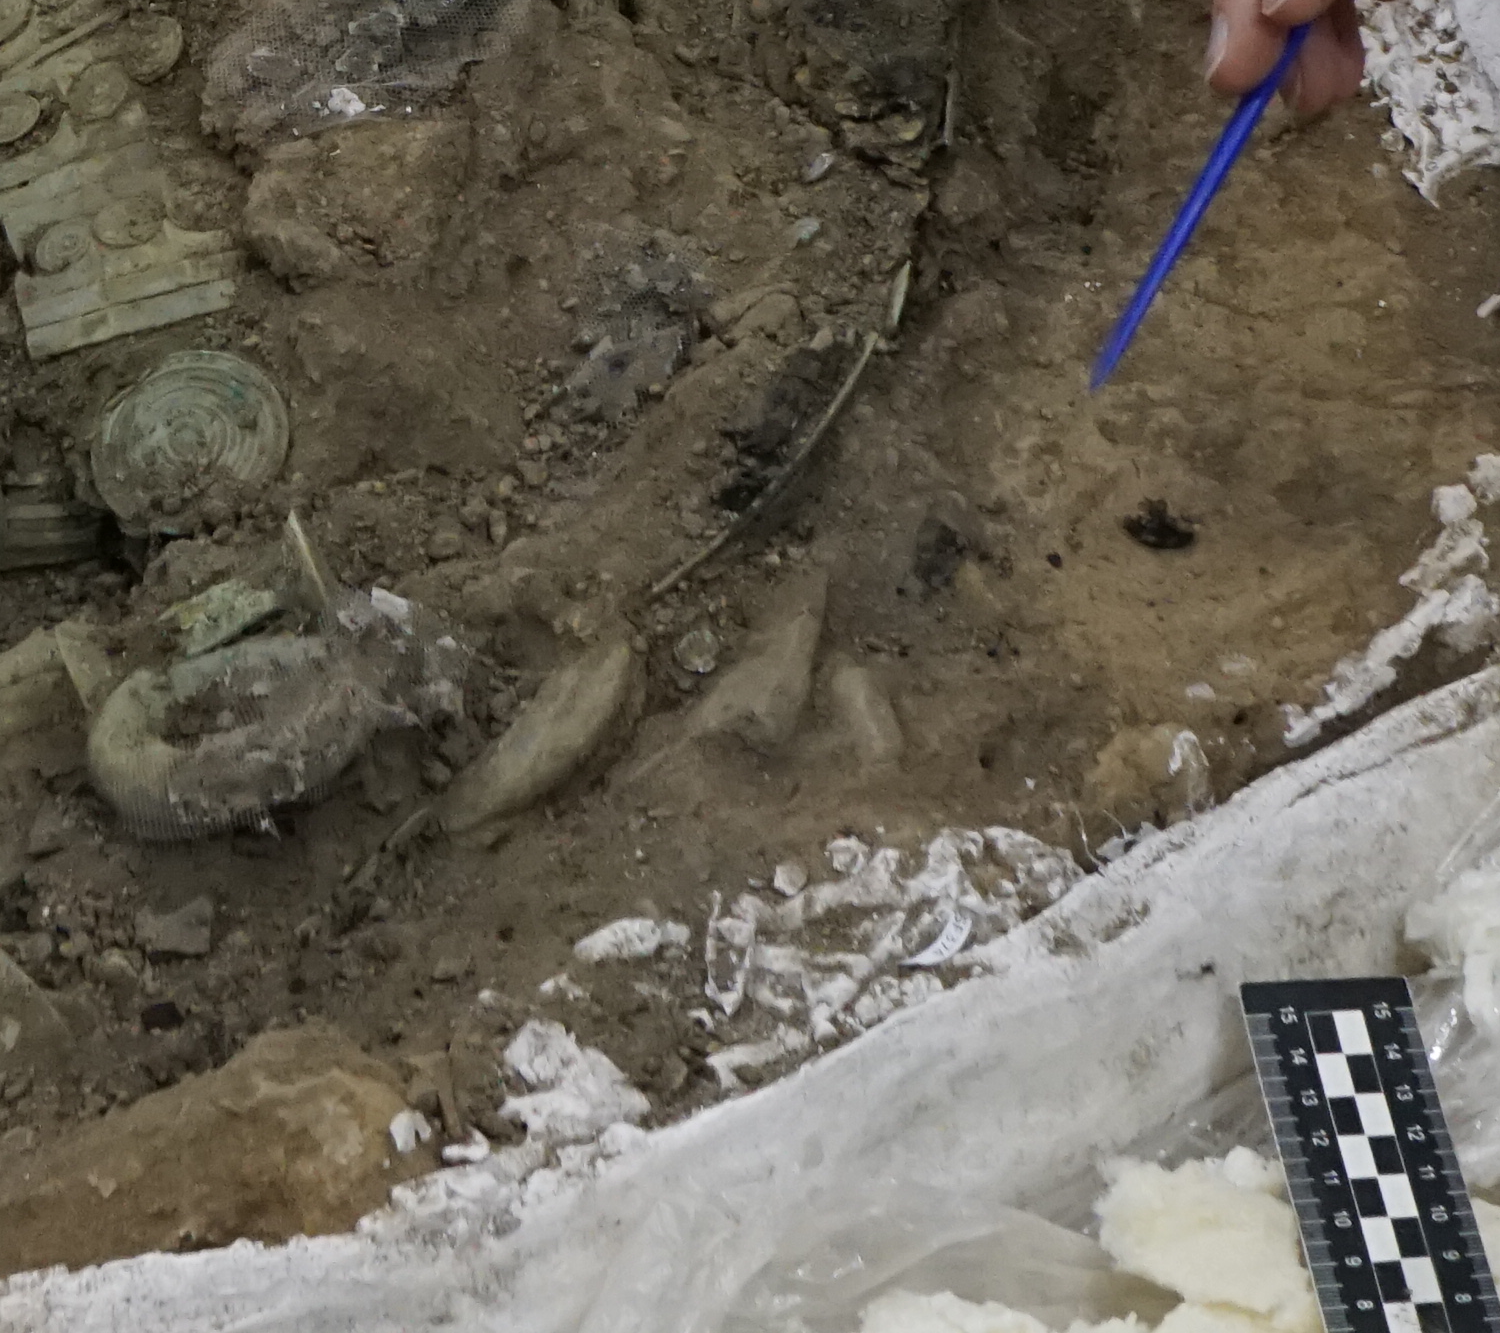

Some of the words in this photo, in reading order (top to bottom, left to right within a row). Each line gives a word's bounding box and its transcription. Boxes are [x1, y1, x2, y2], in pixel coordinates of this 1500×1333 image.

[1278, 1004, 1298, 1025] 15
[1373, 1000, 1392, 1020] 15
[1289, 1046, 1308, 1066] 14
[1384, 1042, 1403, 1061] 14
[1301, 1087, 1319, 1107] 13
[1395, 1083, 1414, 1103] 13
[1312, 1128, 1330, 1148] 12
[1407, 1123, 1426, 1143] 12
[1322, 1169, 1340, 1186] 11
[1419, 1164, 1437, 1181] 11
[1333, 1208, 1353, 1229] 10
[1430, 1203, 1449, 1223] 10
[1344, 1255, 1363, 1267] 9
[1442, 1249, 1461, 1261] 9
[1356, 1299, 1374, 1311] 8
[1454, 1293, 1472, 1305] 8
